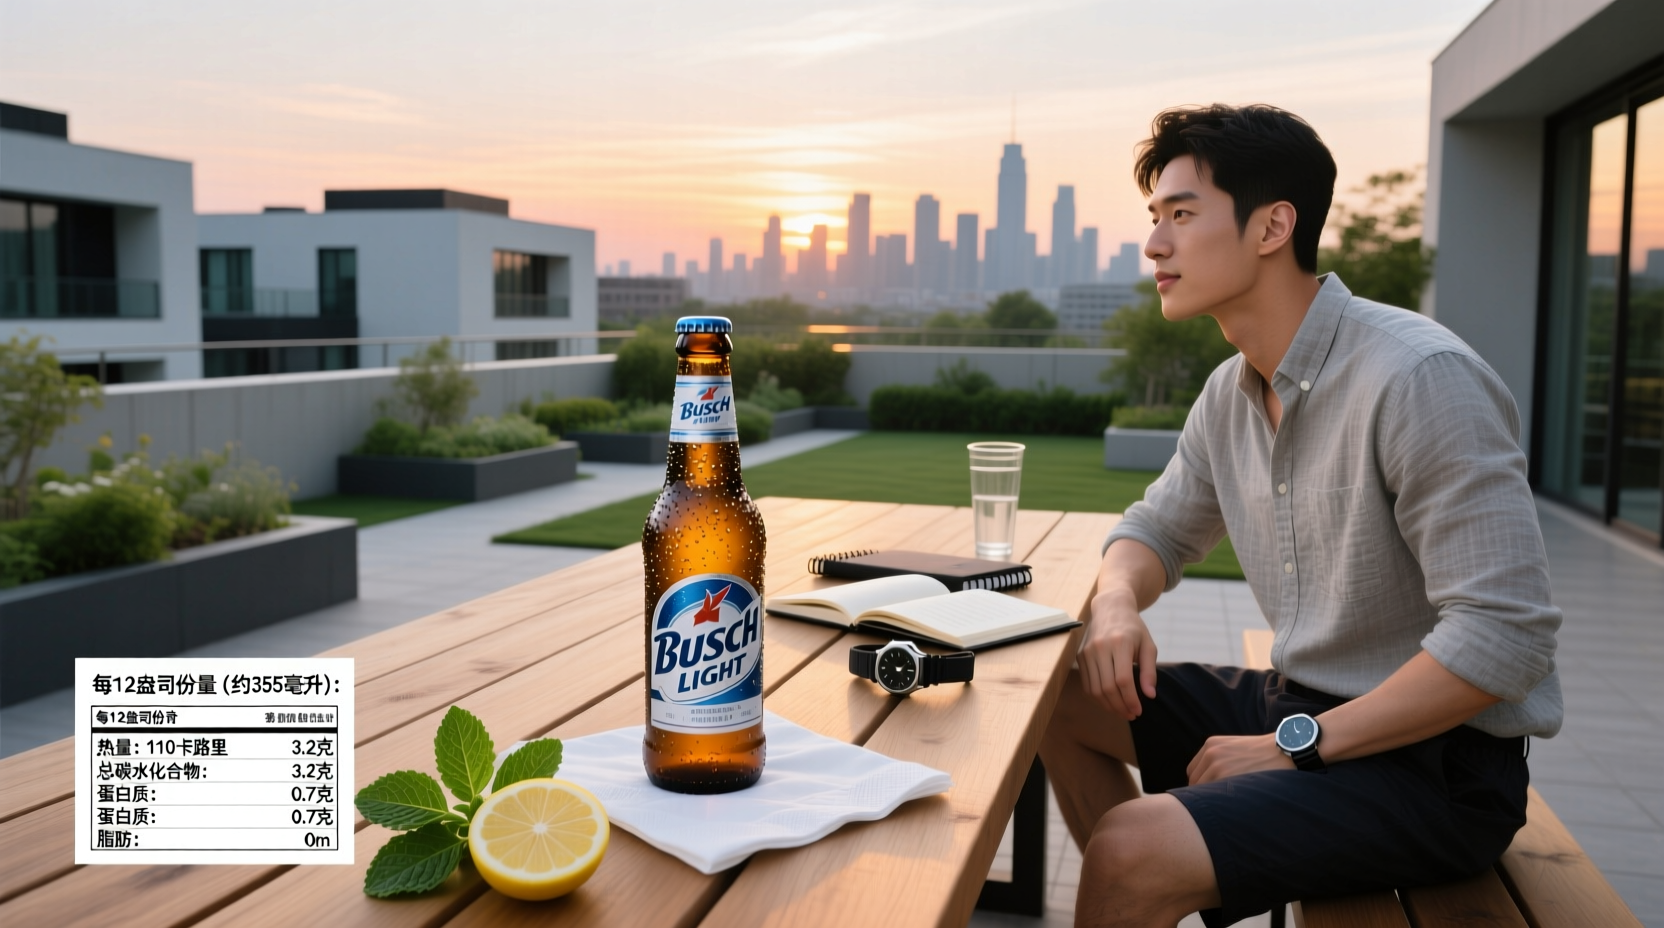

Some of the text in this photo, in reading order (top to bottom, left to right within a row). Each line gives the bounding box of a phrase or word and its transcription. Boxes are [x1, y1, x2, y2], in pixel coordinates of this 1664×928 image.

[680, 395, 731, 421] BUSCH
[654, 606, 759, 675] BUSCH
[677, 652, 747, 694] LIGHT
